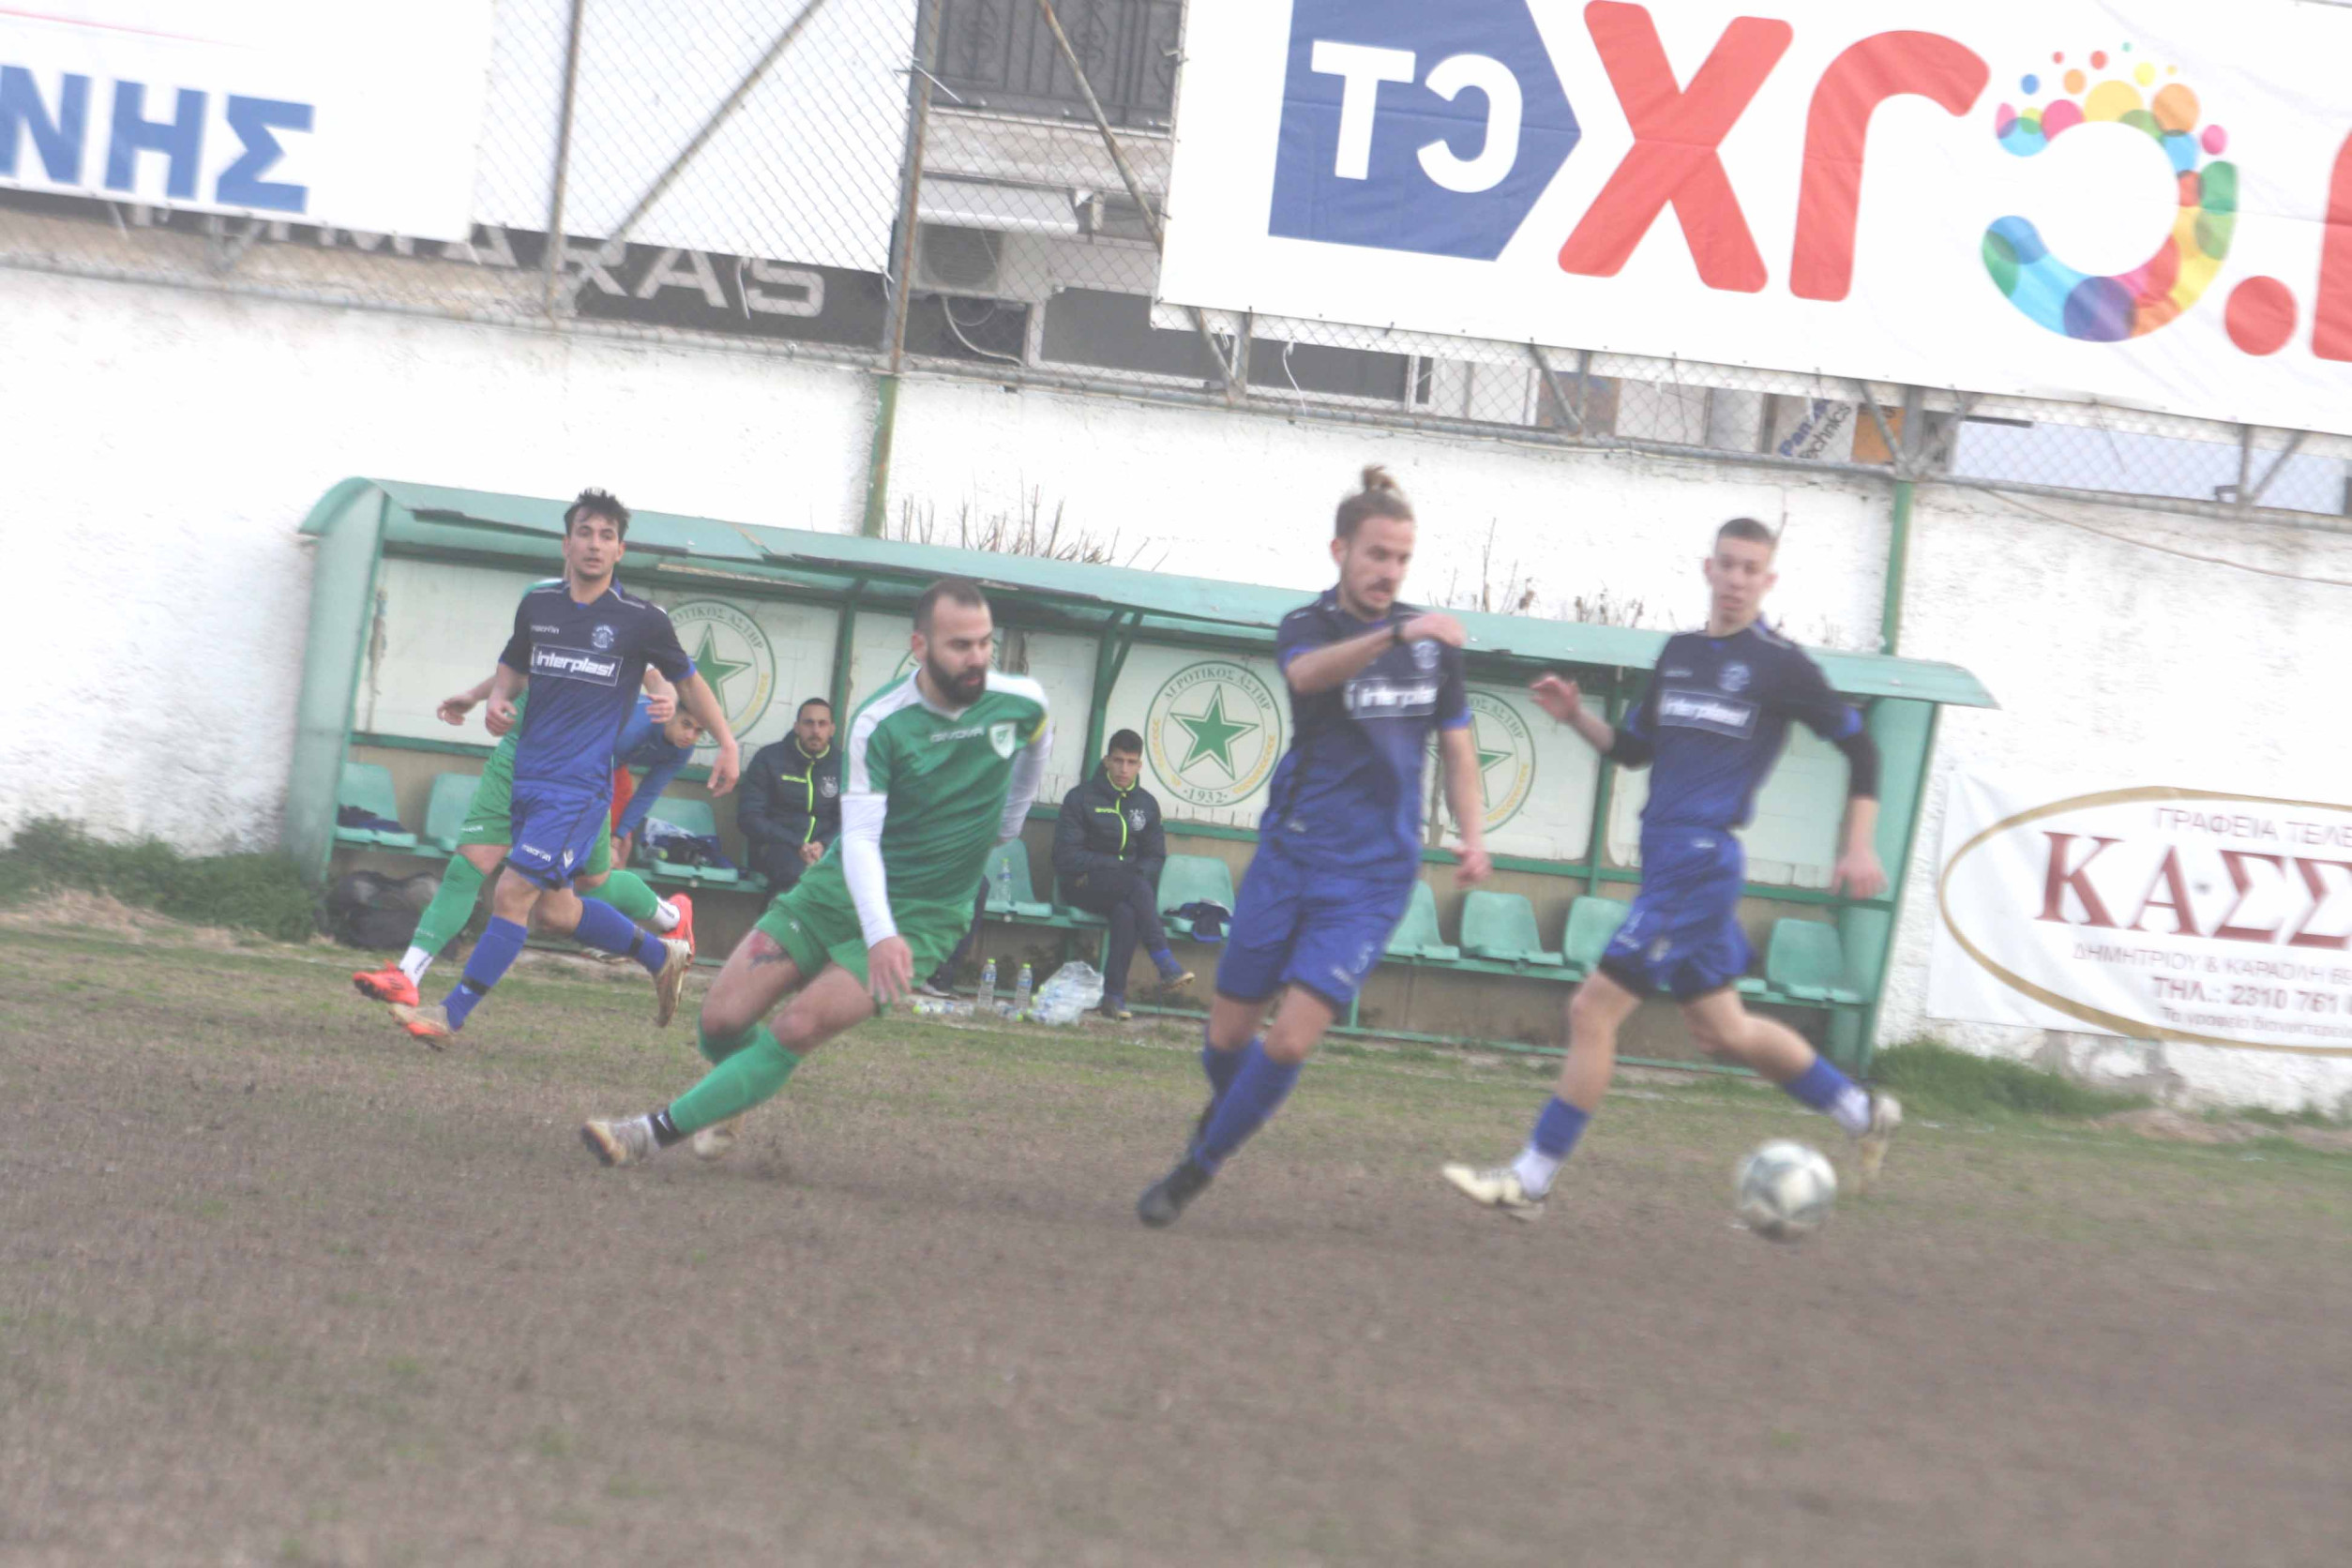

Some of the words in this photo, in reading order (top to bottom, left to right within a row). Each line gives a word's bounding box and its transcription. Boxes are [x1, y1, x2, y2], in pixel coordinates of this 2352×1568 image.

[536, 650, 616, 677] interplast
[1164, 667, 1236, 703] ΑΓΡΟΤΙΚΟΣ
[2154, 807, 2279, 841] ΓΡΑΦΕΙΑ
[2073, 942, 2199, 973] ΔΗΜΗΤΡΙΟΥ
[2227, 983, 2288, 1012] 2310
[2296, 989, 2339, 1016] 761
